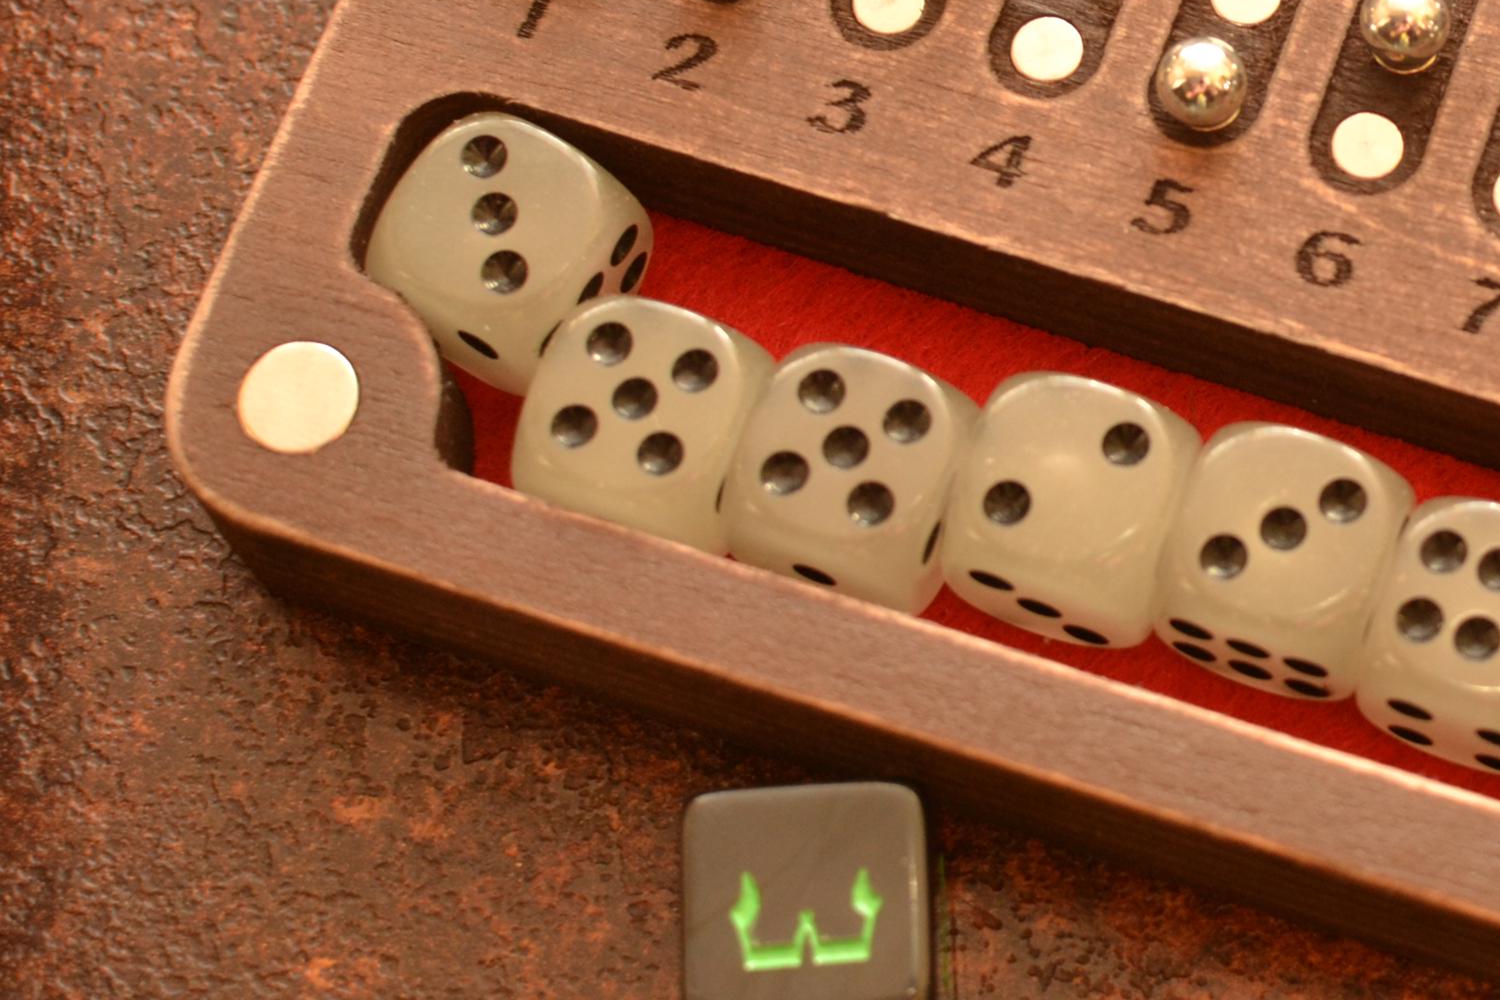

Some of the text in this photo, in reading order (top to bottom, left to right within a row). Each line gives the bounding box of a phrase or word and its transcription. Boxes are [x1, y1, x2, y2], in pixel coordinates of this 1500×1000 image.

[651, 33, 719, 92] 2
[807, 79, 874, 135] 3
[970, 134, 1033, 188] 4
[1129, 176, 1195, 236] 5
[1294, 230, 1364, 289] 6
